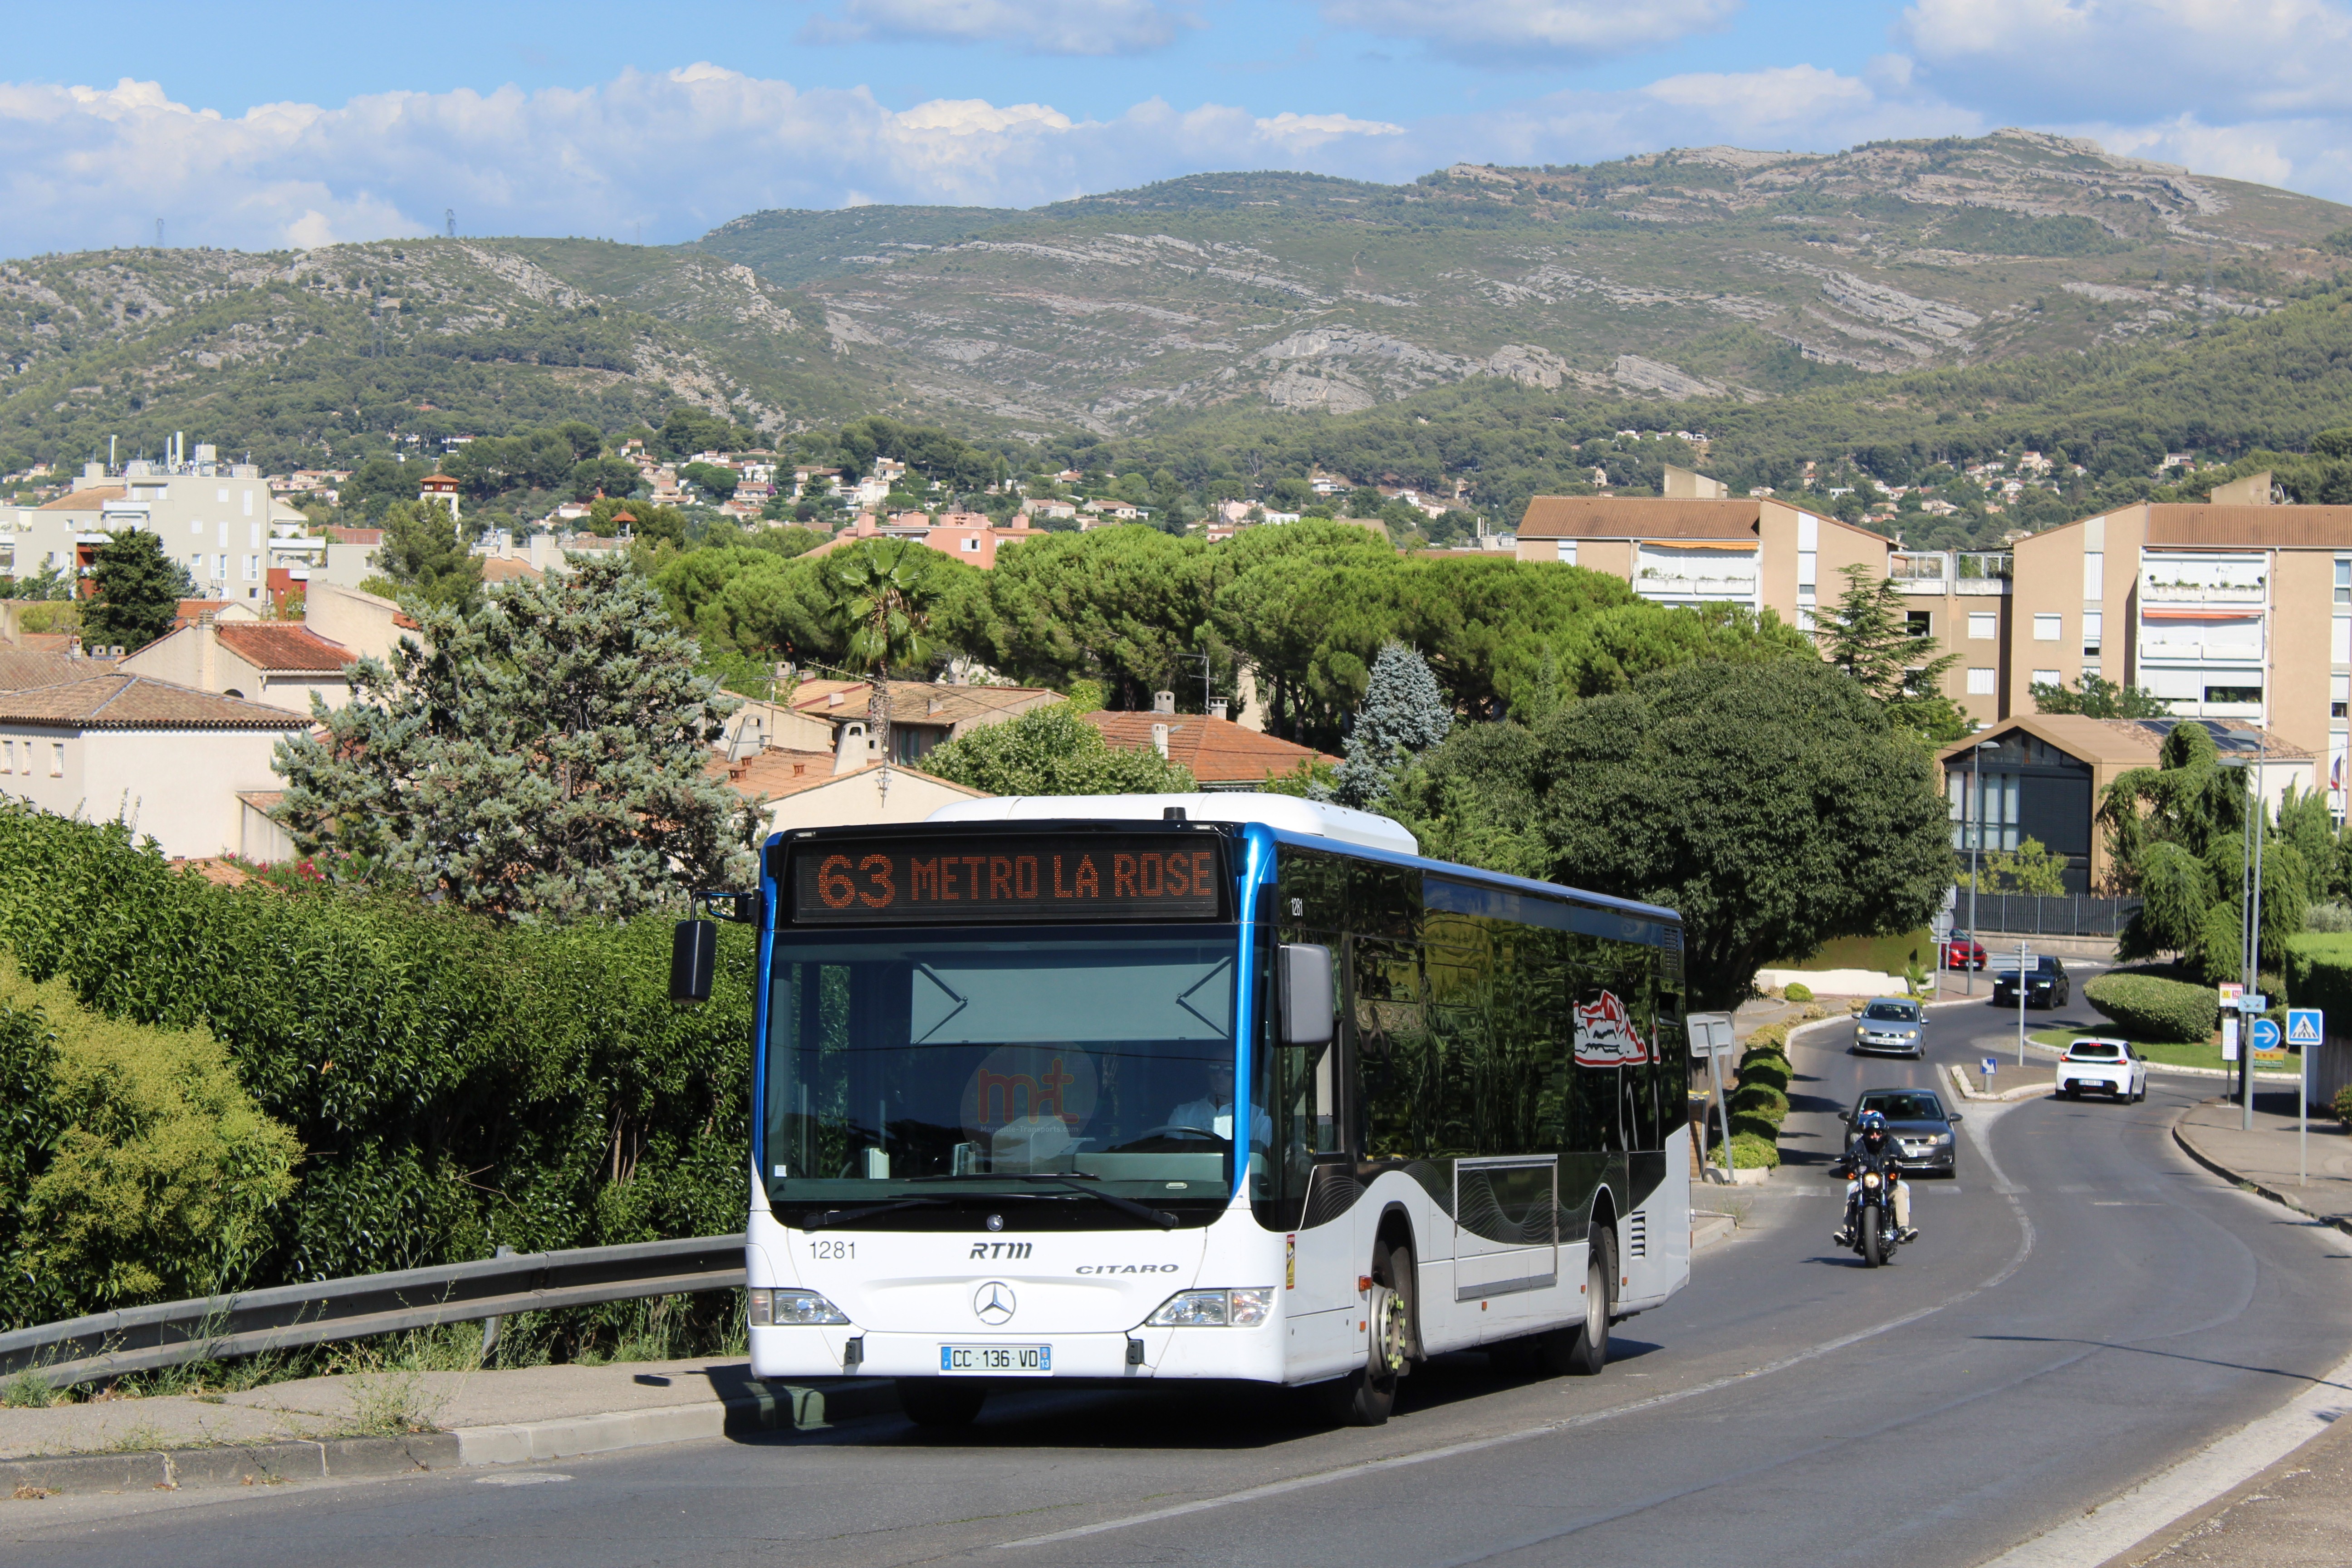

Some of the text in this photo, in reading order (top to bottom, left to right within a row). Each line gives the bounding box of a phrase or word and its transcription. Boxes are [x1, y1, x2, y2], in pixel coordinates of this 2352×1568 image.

[819, 853, 1211, 908] 63 METRO LA ROSE
[1291, 897, 1303, 916] 1281
[809, 1241, 856, 1260] 1281
[969, 1242, 1033, 1259] RTM
[1075, 1263, 1179, 1275] CITARO
[1041, 1359, 1049, 1368] 13
